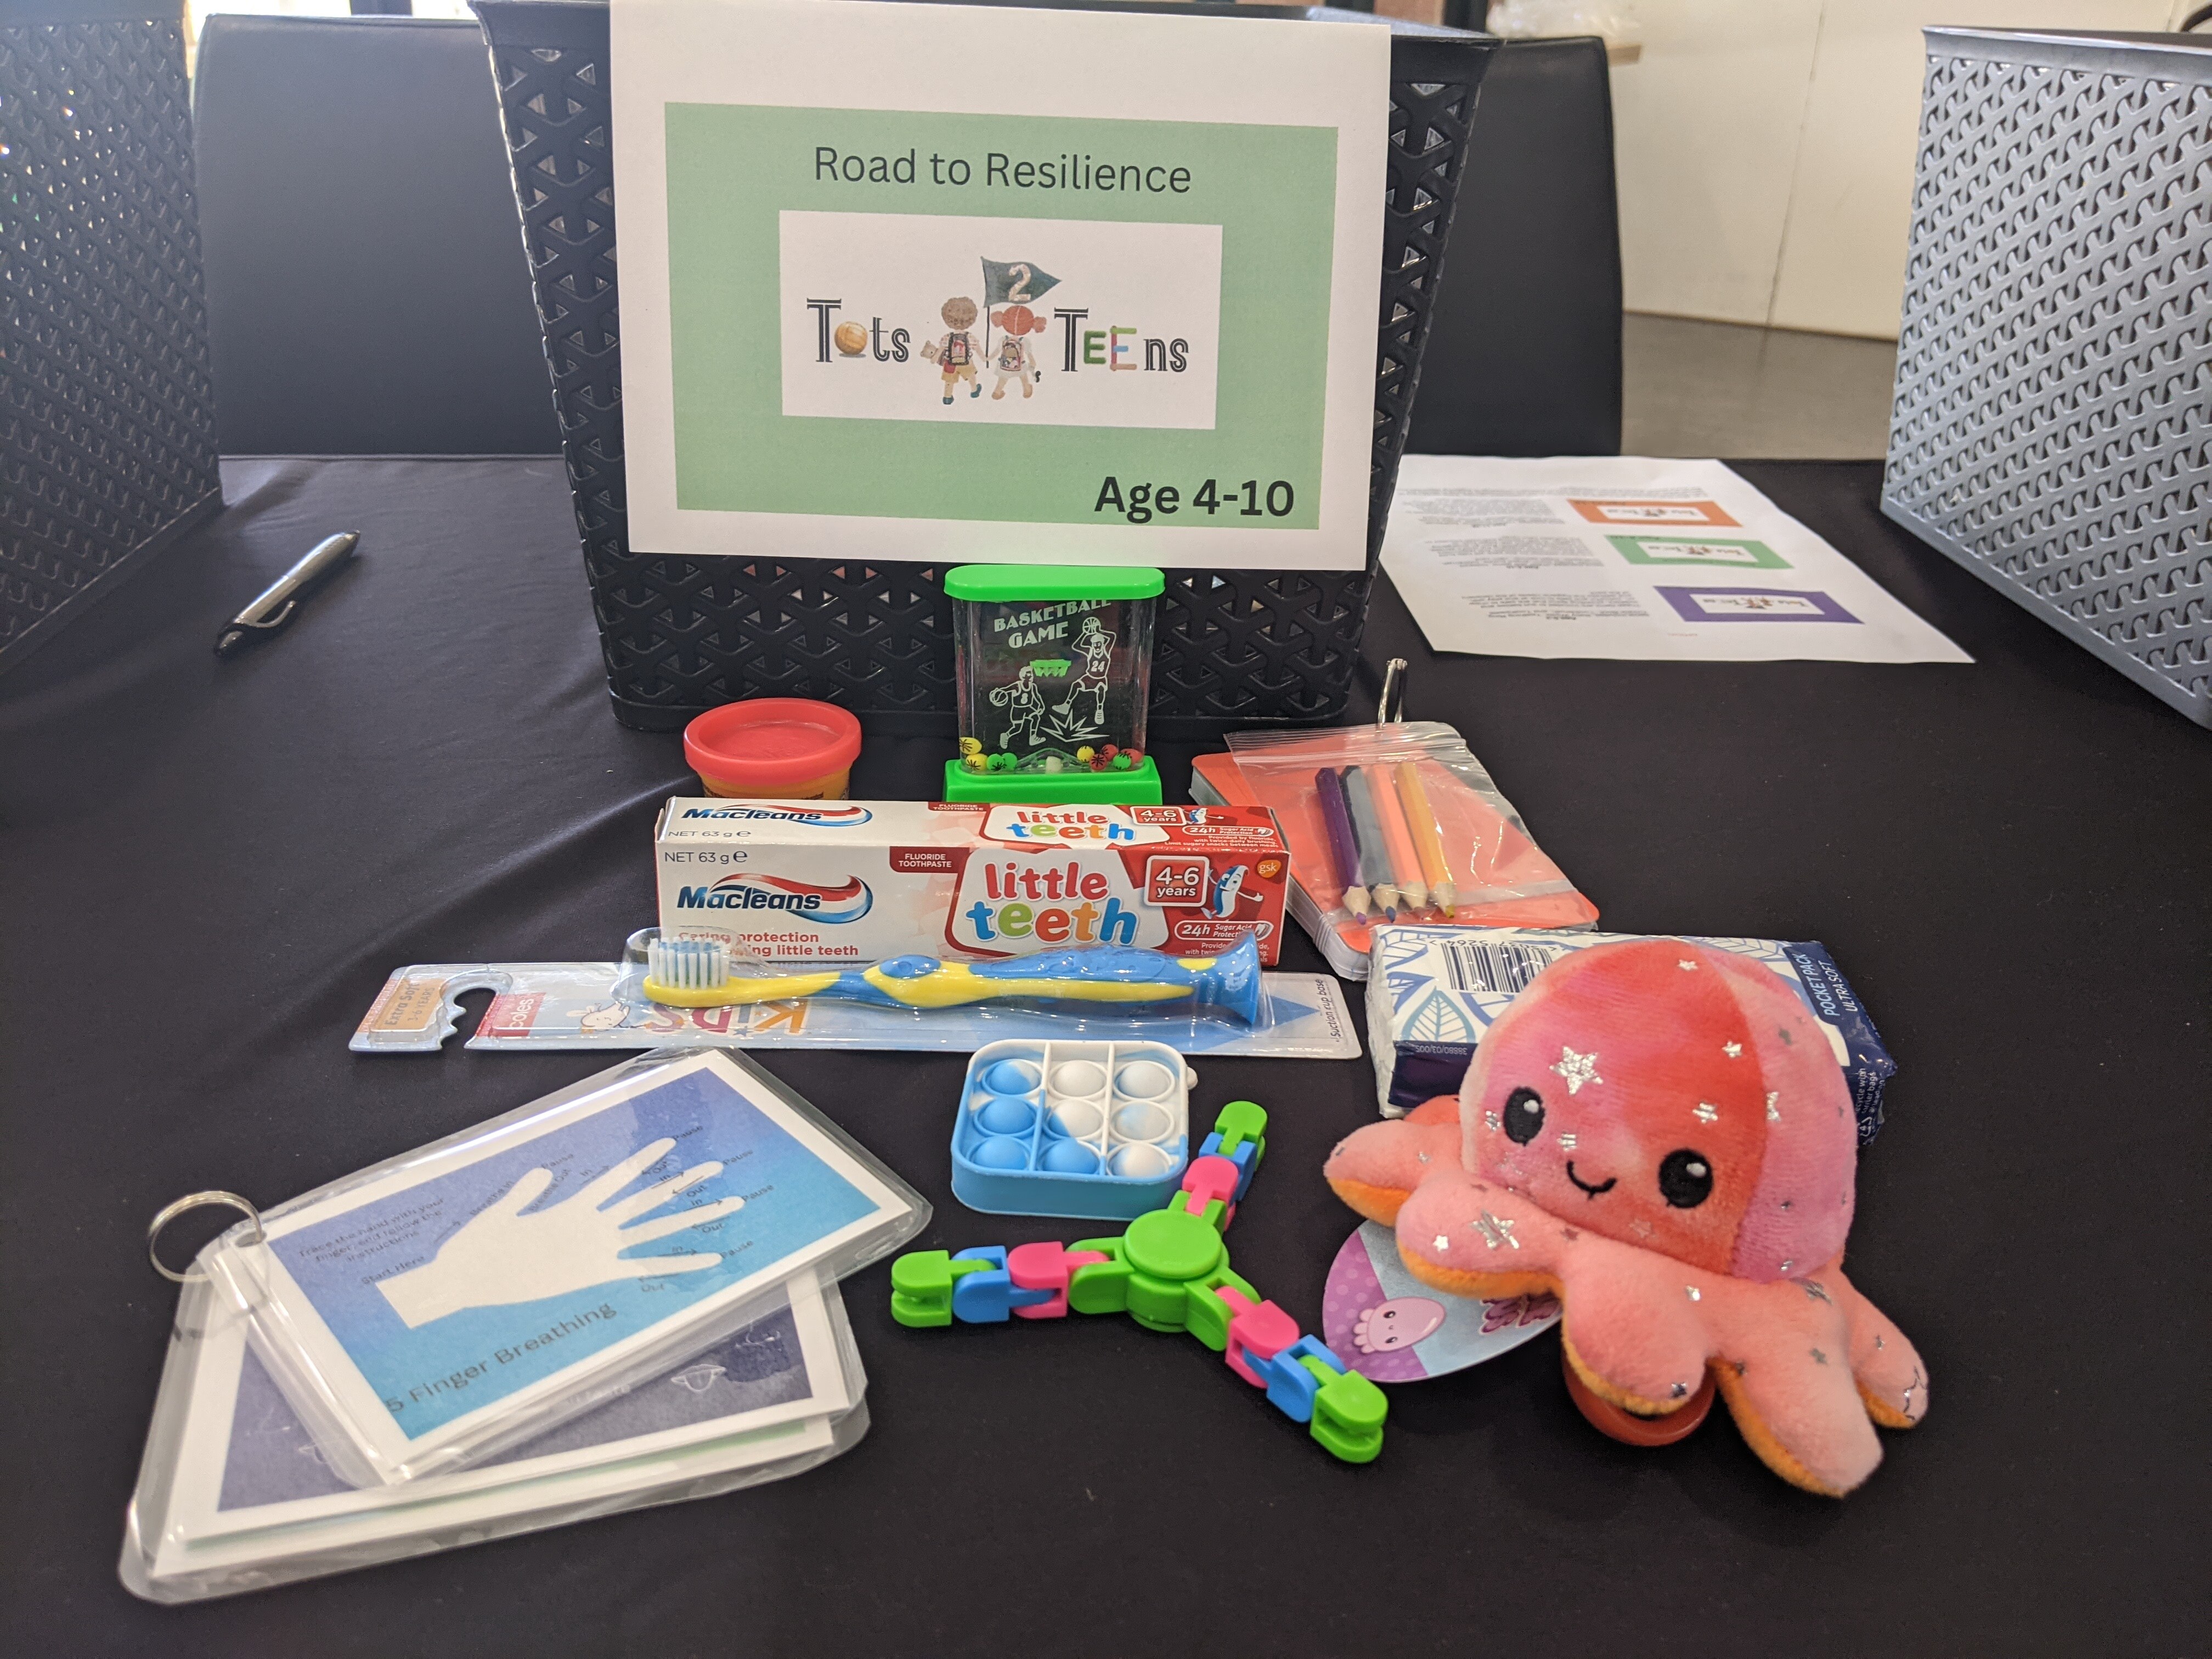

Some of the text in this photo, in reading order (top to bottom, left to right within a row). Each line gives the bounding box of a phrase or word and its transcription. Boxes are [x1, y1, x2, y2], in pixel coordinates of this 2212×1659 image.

[815, 146, 1191, 194] Road to Resilience
[1008, 263, 1032, 301] 2
[1094, 476, 1294, 523] Age 4-10
[994, 600, 1111, 633] BASKETBALL
[1008, 621, 1068, 648] GAME
[1091, 660, 1105, 672] 24
[681, 808, 823, 820] Macleans
[1017, 811, 1109, 823] little
[1006, 823, 1135, 840] teeth
[665, 852, 694, 862] NET
[699, 852, 716, 862] 63
[1259, 862, 1277, 874] gsk
[985, 861, 1108, 900] little
[1155, 866, 1199, 885] 4-6
[677, 886, 821, 910] Macleans
[1157, 887, 1196, 898] years
[966, 897, 1137, 944] teeth
[1182, 924, 1210, 936] 24h
[777, 945, 812, 956] little
[817, 945, 859, 956] teeth
[1792, 953, 1840, 1015] POCKET PACK
[1818, 961, 1858, 1011] ULTRA SOFT
[385, 1002, 408, 1025] Extra
[509, 998, 534, 1027] coles
[385, 1302, 618, 1413] 5 Finger Breathing
